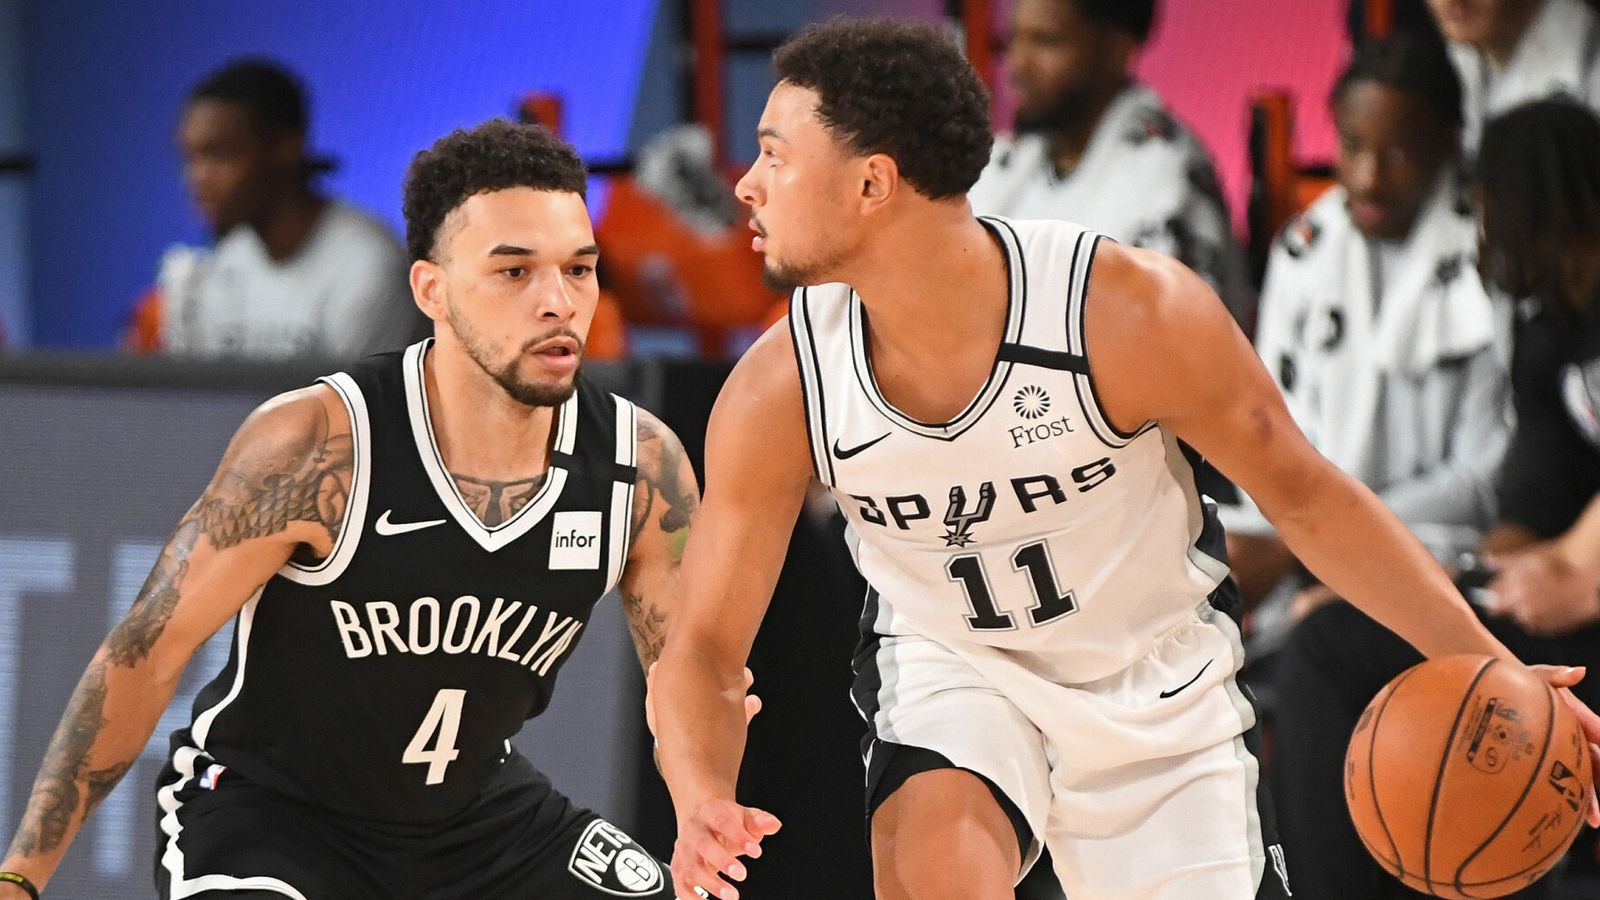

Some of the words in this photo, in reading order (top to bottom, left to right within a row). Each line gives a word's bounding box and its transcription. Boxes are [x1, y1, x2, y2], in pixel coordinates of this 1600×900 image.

[1008, 415, 1074, 448] Frost
[555, 529, 596, 548] infor
[944, 538, 1080, 632] 11
[331, 595, 583, 677] BROOKLYN
[402, 688, 467, 785] 4
[575, 821, 632, 885] NETS
